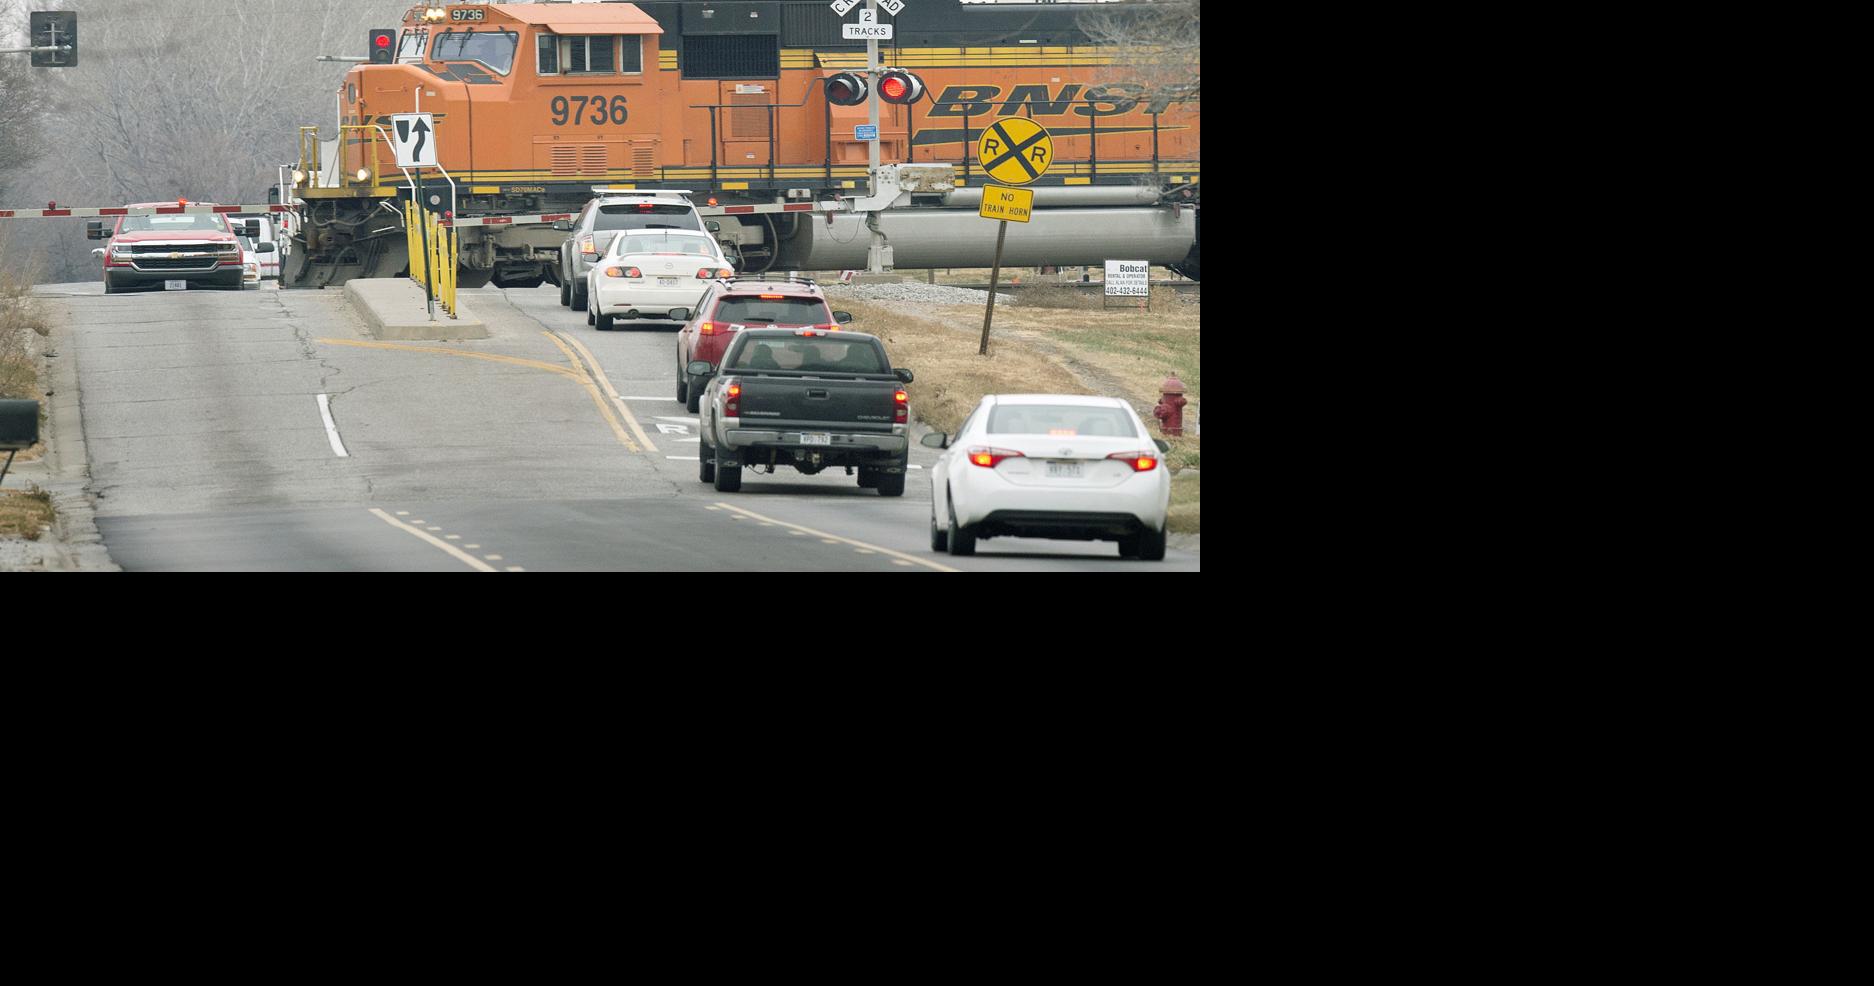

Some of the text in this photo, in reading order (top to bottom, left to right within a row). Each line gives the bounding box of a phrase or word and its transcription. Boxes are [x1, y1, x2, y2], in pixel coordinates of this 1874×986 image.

[452, 9, 483, 20] 9736
[863, 11, 872, 22] 2
[849, 27, 886, 36] TRACKS
[550, 95, 628, 126] 9736
[984, 138, 1046, 163] R R
[1001, 193, 1015, 202] NO
[984, 203, 1028, 217] TRAIN HORN
[1119, 264, 1147, 272] Bobcat
[656, 424, 689, 434] R
